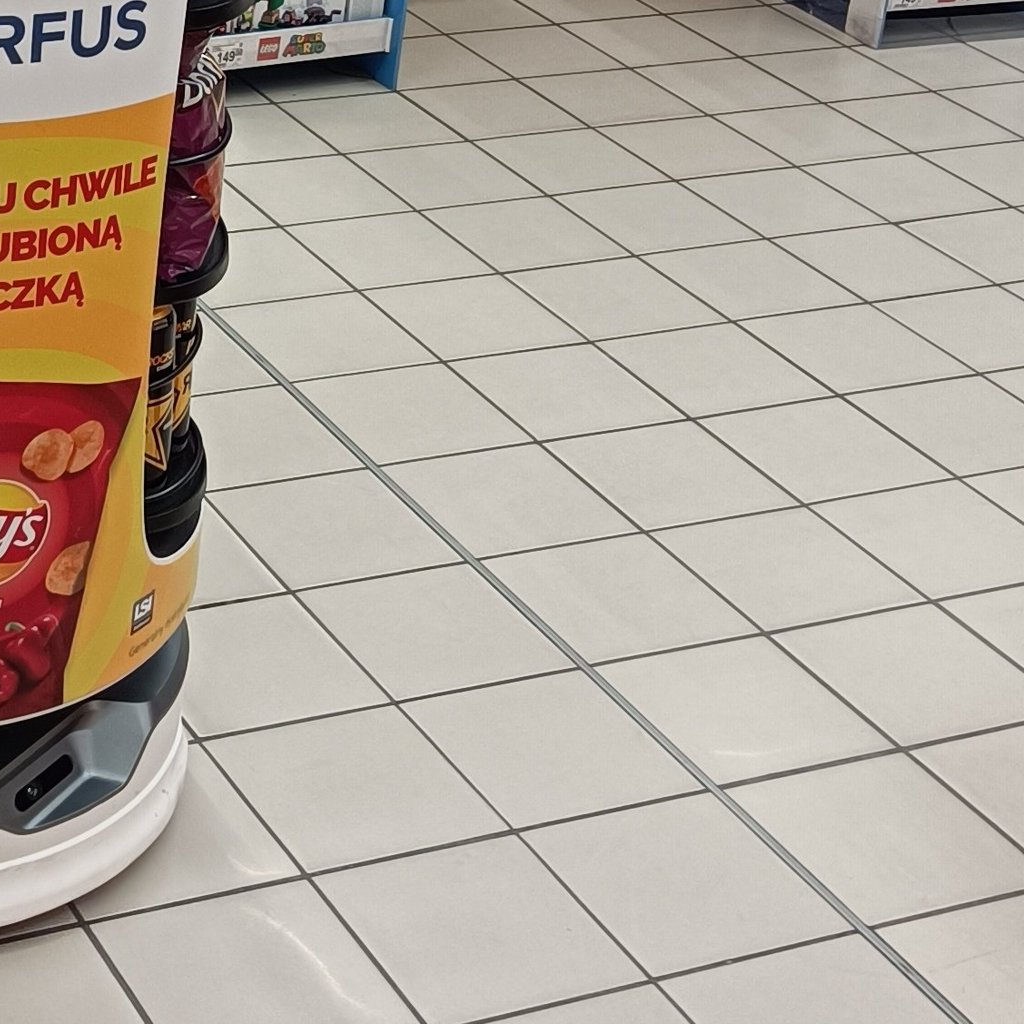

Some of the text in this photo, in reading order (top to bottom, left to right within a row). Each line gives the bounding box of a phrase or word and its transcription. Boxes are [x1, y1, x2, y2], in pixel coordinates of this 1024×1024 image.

[217, 51, 236, 63] 149
[23, 154, 158, 210] CHWILE
[134, 594, 153, 621] LSI
